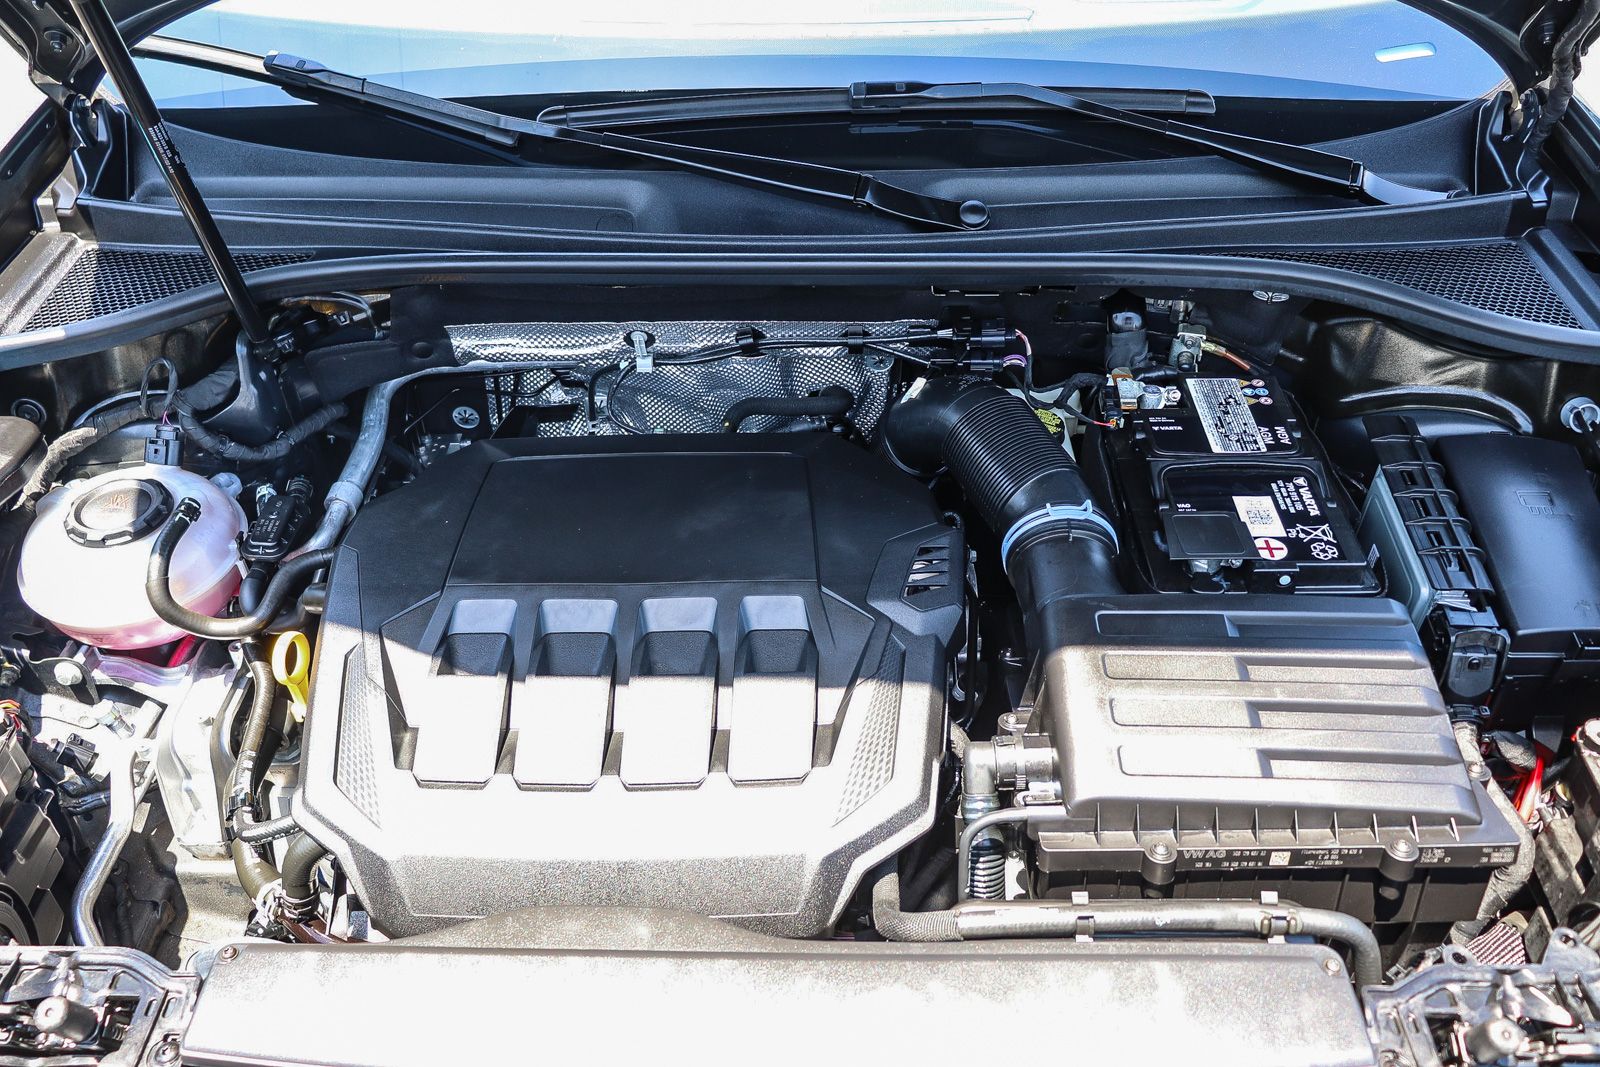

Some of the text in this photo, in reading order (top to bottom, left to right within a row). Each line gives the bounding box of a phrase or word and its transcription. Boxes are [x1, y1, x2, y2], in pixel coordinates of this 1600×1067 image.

[1258, 426, 1275, 444] AGM
[1274, 426, 1292, 444] AGM
[1299, 487, 1320, 516] VARTA
[1286, 528, 1298, 538] Pb
[1183, 849, 1205, 859] VW
[1206, 849, 1226, 859] AG
